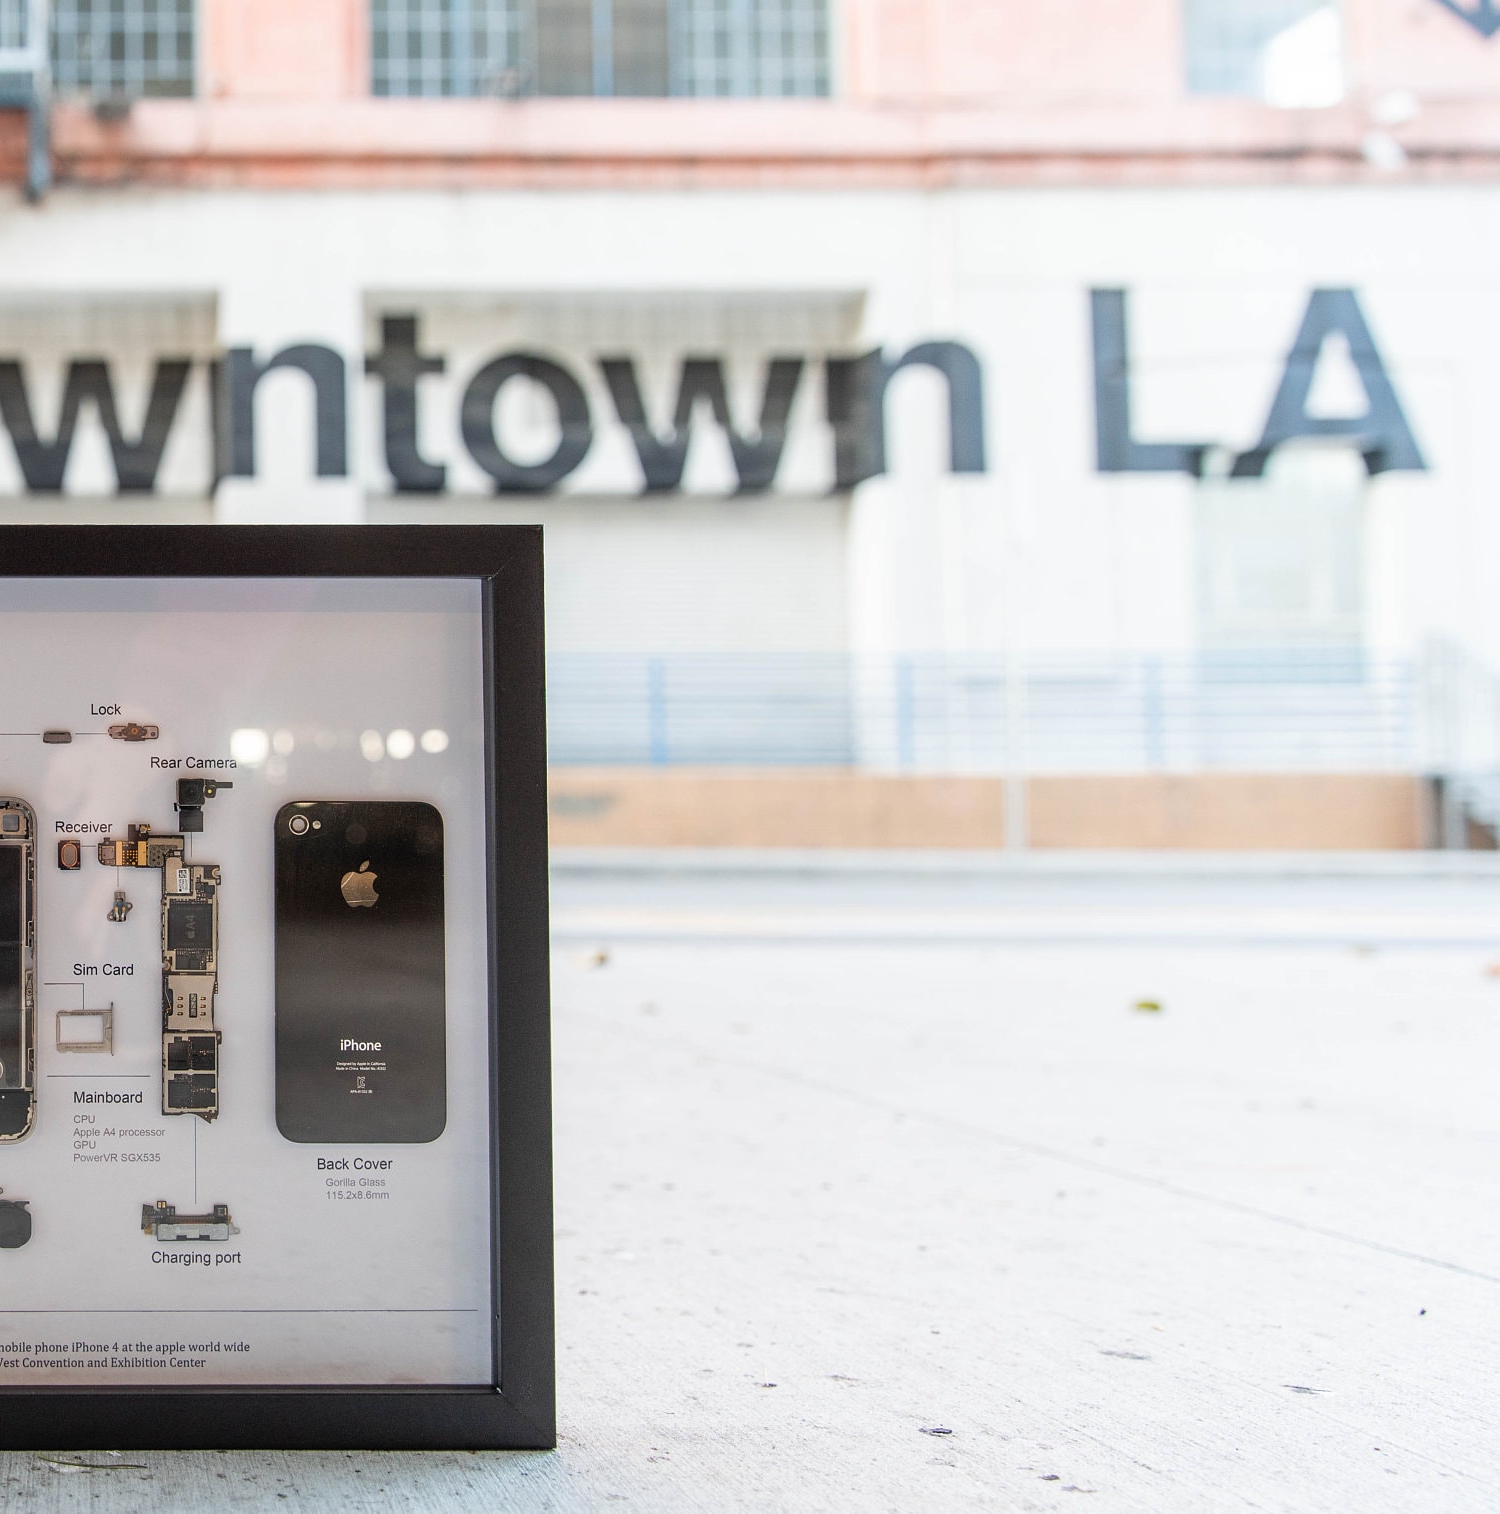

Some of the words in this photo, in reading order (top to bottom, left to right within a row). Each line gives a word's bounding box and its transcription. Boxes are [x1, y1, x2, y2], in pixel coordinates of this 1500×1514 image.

[1087, 286, 1429, 477] LA
[90, 704, 122, 715] Lock
[150, 757, 183, 768] Rear
[185, 757, 237, 768] Camera
[55, 821, 113, 833] Receiver
[72, 964, 98, 975] Sim
[102, 964, 134, 975] Card
[340, 1039, 382, 1051] iPhone
[73, 1091, 143, 1103] Mainboard
[73, 1115, 96, 1123] CPU
[72, 1128, 101, 1138] Apple
[102, 1128, 117, 1136] A4
[118, 1130, 167, 1138] processor
[73, 1141, 97, 1149] GPU
[73, 1153, 118, 1162] PowerVR
[120, 1153, 161, 1162] SGX535
[318, 1158, 349, 1169] Back
[353, 1158, 394, 1169] Cover
[325, 1178, 356, 1186] Gorilla
[358, 1178, 386, 1186] Glass
[151, 1251, 211, 1266] Charging
[215, 1252, 242, 1266] port
[34, 1342, 69, 1355] phone
[71, 1342, 110, 1352] iPhone
[111, 1342, 120, 1352] 4
[121, 1344, 134, 1352] at
[135, 1342, 153, 1352] the
[155, 1342, 186, 1355] apple
[188, 1342, 221, 1352] world
[223, 1342, 251, 1352] wide
[22, 1358, 85, 1368] Convention
[87, 1357, 108, 1367] and
[110, 1357, 167, 1367] Exhibition
[169, 1358, 207, 1367] Center
